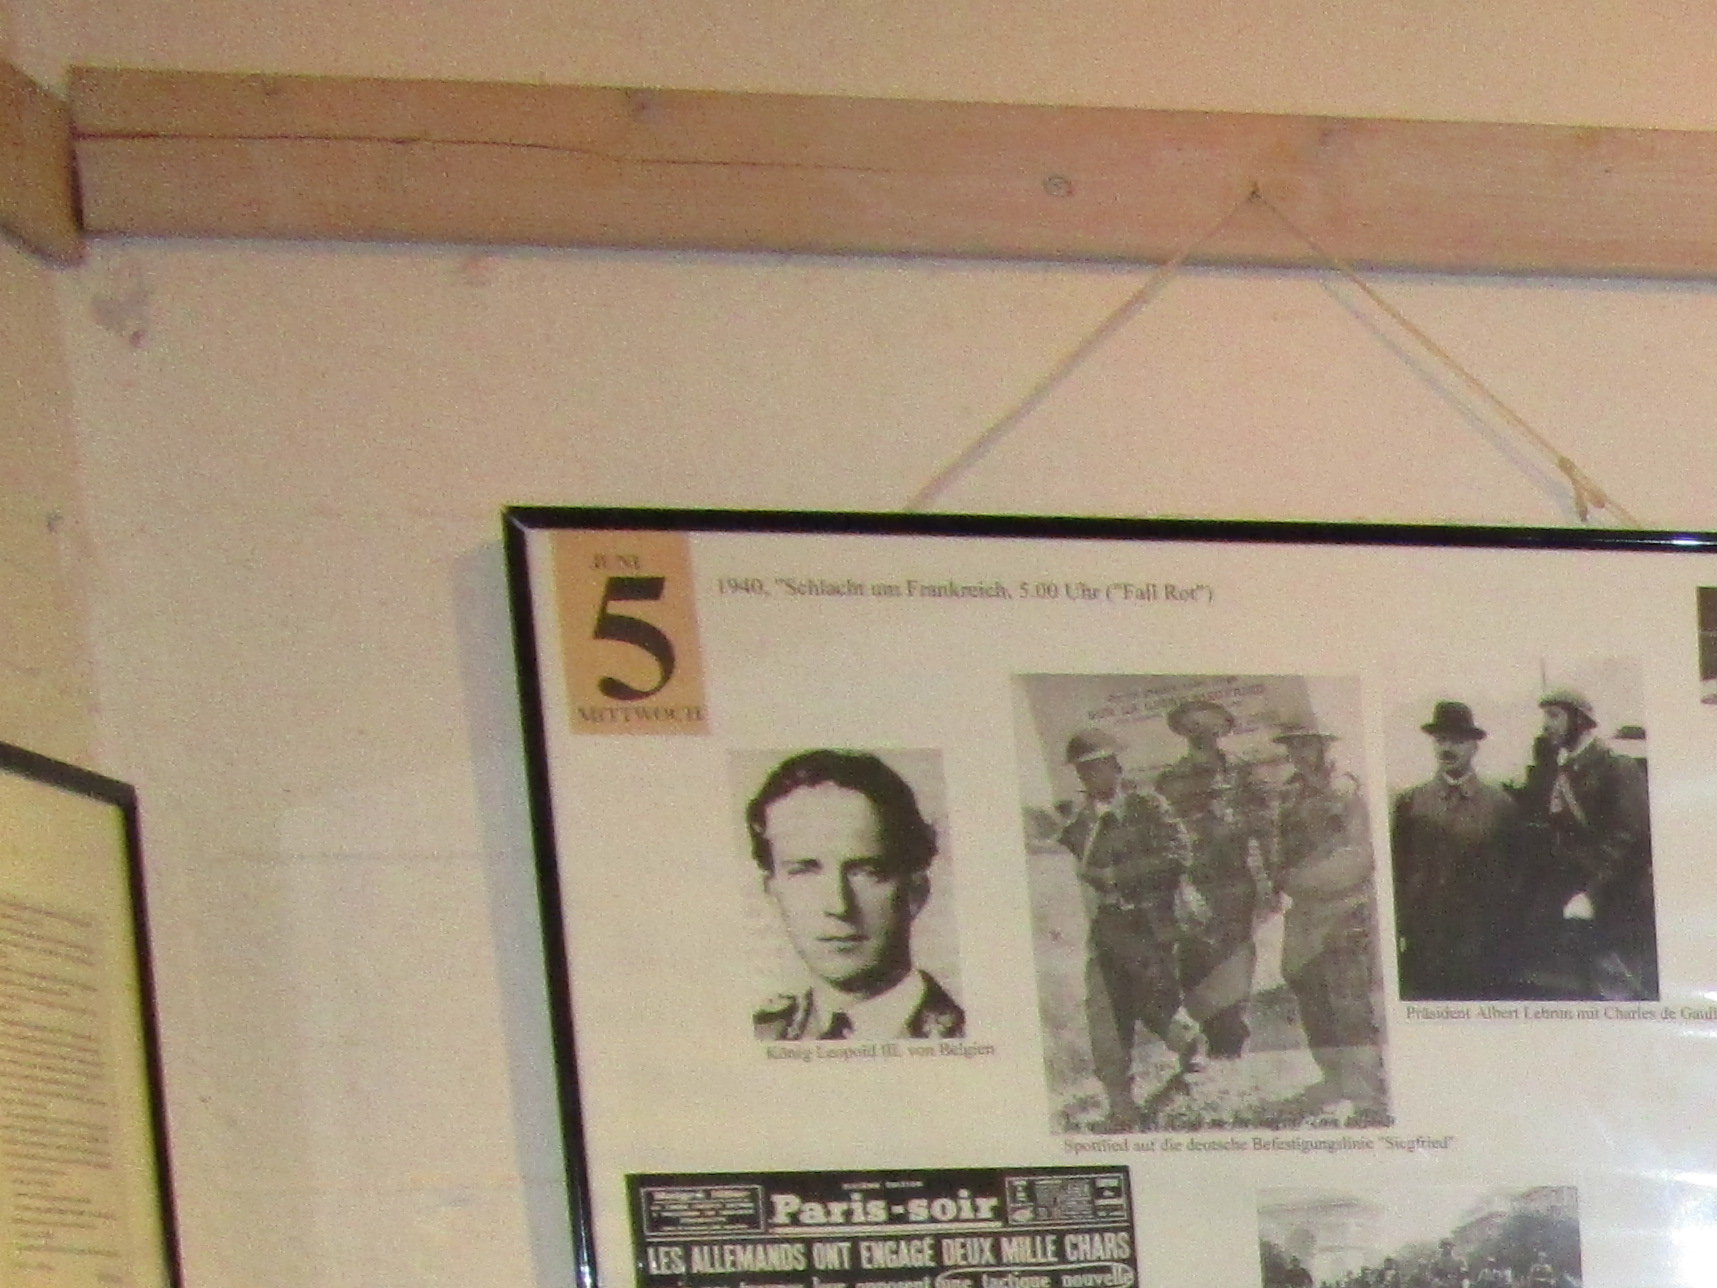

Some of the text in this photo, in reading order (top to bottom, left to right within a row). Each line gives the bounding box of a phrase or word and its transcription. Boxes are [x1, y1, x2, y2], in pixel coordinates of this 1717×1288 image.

[717, 578, 770, 599] 1940,
[1020, 582, 1057, 598] 5.00
[1065, 582, 1100, 599] Uhr
[594, 575, 676, 700] 5
[1407, 1006, 1470, 1019] Präsident
[1478, 1006, 1519, 1019] Albert
[1577, 1006, 1599, 1019] mit
[1605, 1006, 1656, 1019] Charles
[1661, 1006, 1677, 1019] de
[907, 1048, 934, 1056] von
[1133, 1138, 1155, 1151] auf
[1160, 1138, 1181, 1150] die
[1186, 1137, 1248, 1150] deutsche
[769, 1190, 1000, 1224] Paris-soir
[647, 1247, 685, 1275] LES
[691, 1242, 805, 1274] ALLEMANDS
[813, 1241, 851, 1270] ONT
[943, 1236, 994, 1266] DEUX
[1002, 1235, 1056, 1264] MILLE
[1065, 1232, 1130, 1262] CHARS
